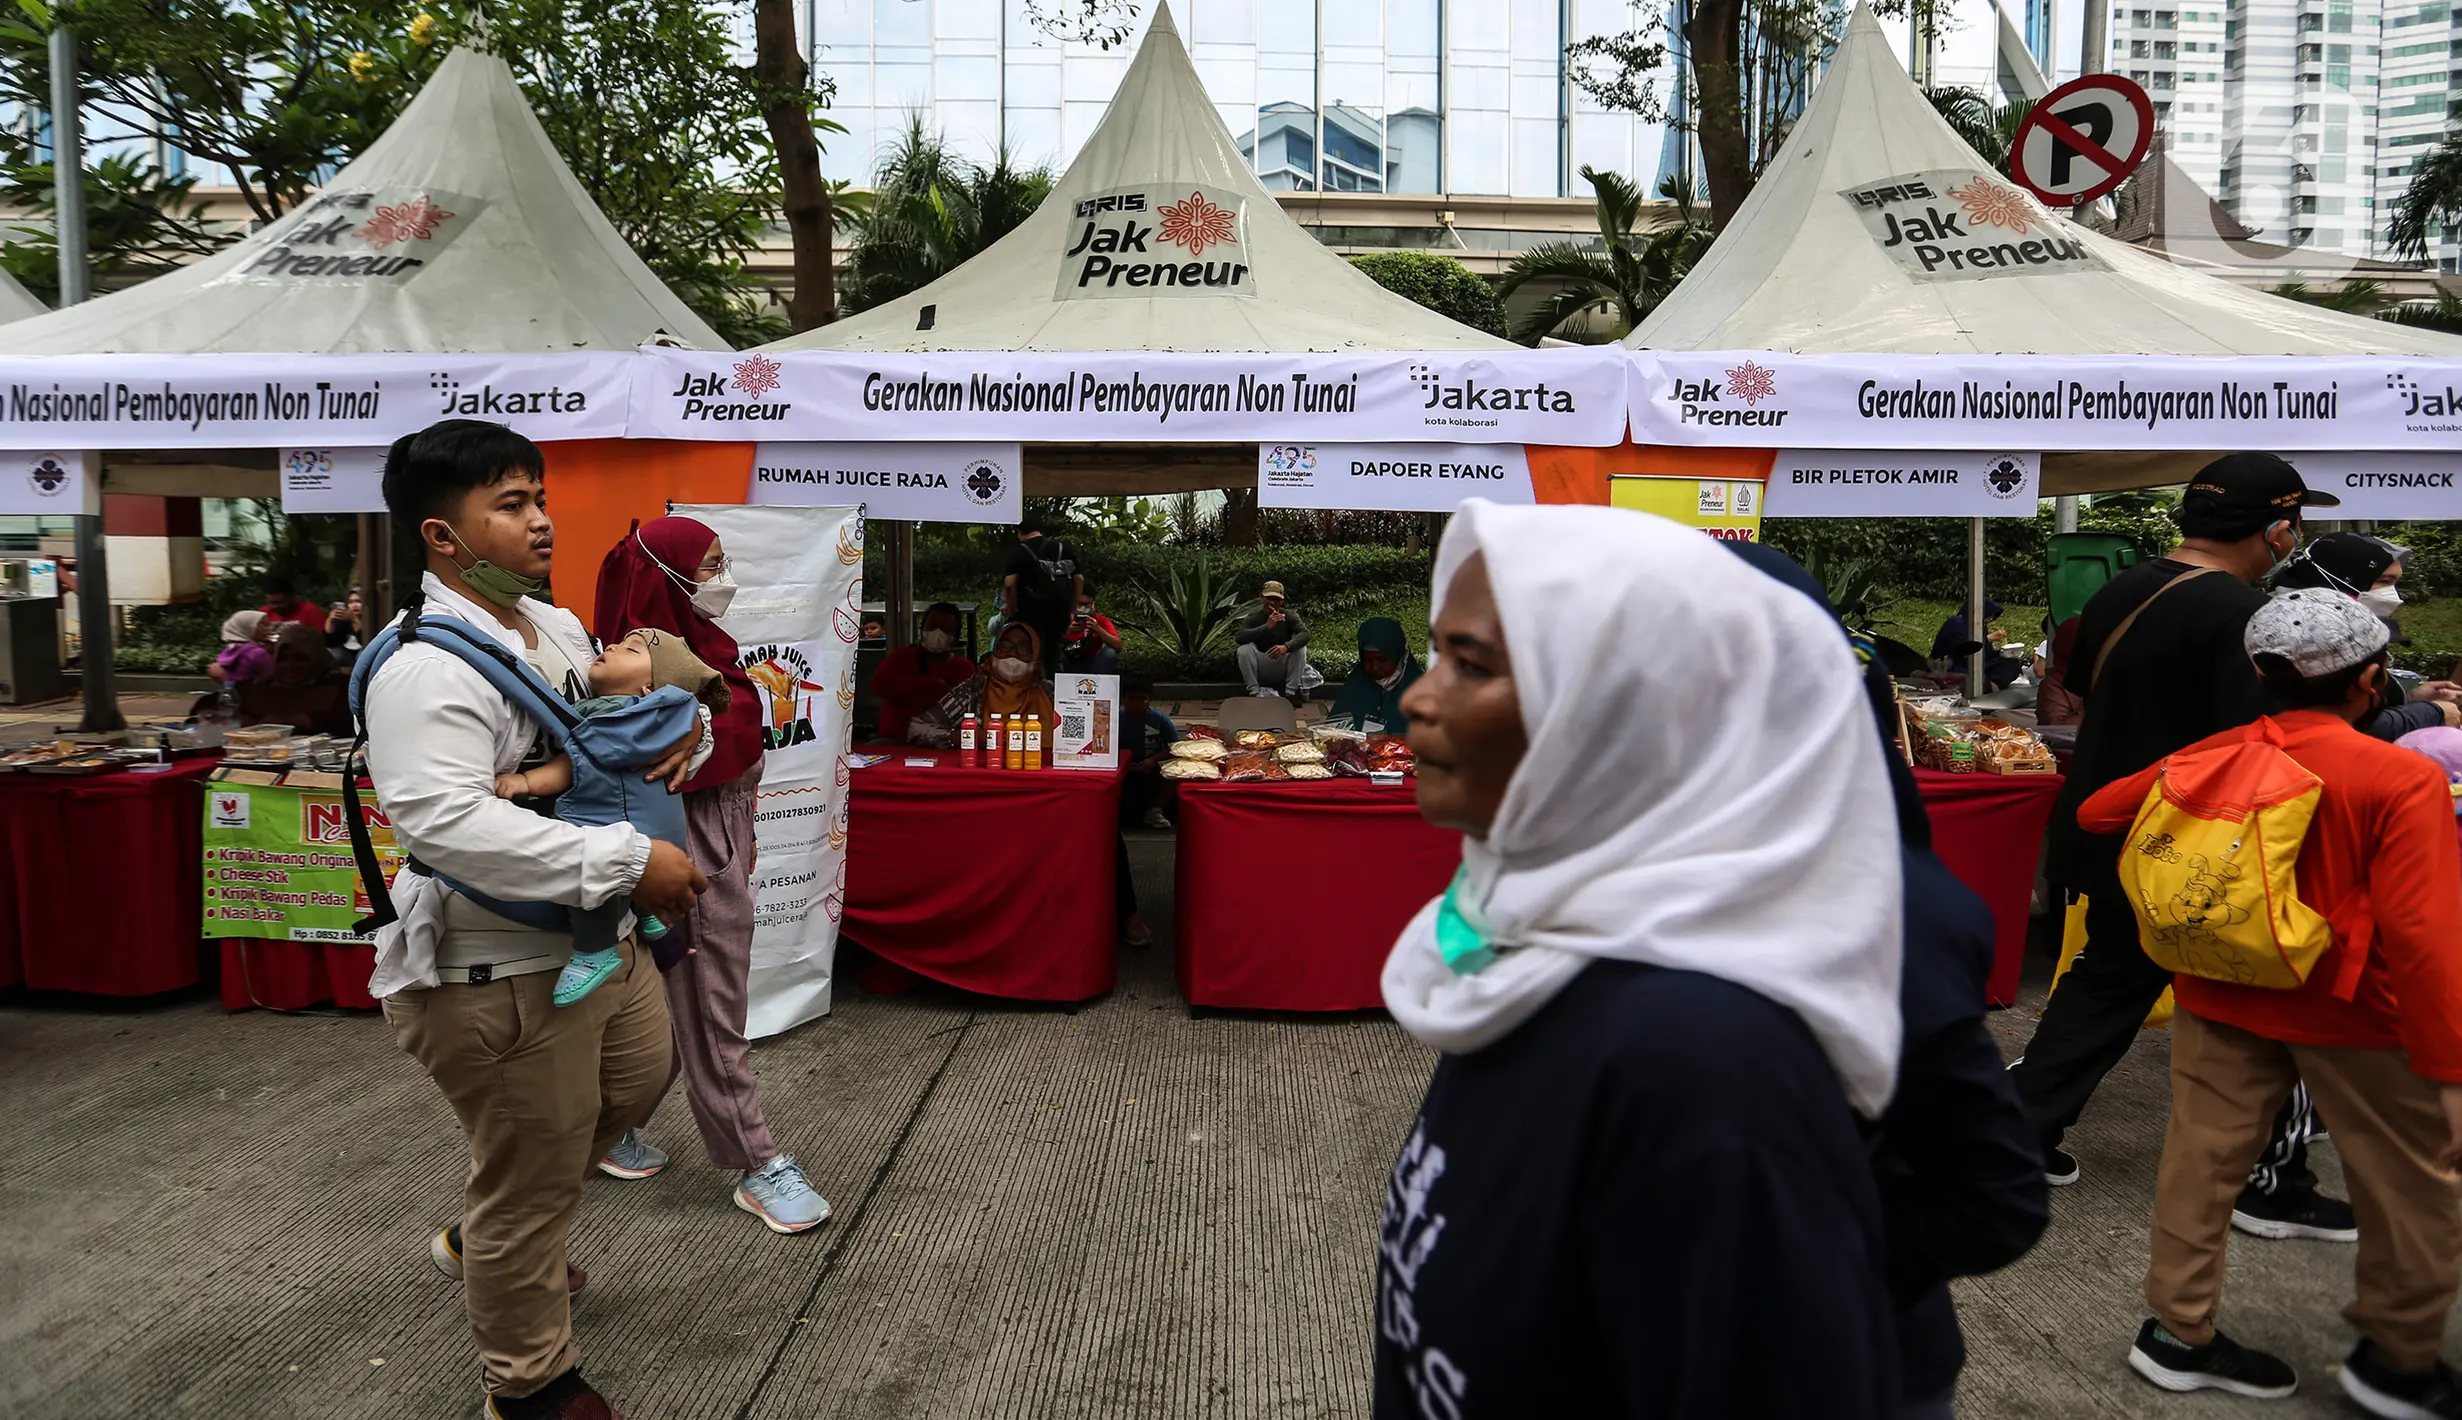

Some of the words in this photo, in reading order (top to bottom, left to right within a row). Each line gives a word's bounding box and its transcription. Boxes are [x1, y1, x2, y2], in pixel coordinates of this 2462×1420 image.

[1884, 207, 1967, 247] Jak
[1067, 220, 1152, 257] Jak
[246, 247, 423, 276] Preneur
[1913, 238, 2088, 271] Preneur
[1078, 255, 1249, 288] Preneur
[673, 372, 728, 397] Jak
[1668, 379, 1722, 402] Jak
[10, 384, 109, 422] Nasional
[116, 382, 258, 432] Pembayaran
[264, 383, 309, 421] Non
[316, 381, 380, 420] Tunai
[864, 372, 963, 412] Gerakan
[969, 372, 1074, 413] Nasional
[1079, 372, 1230, 424] Pembayaran
[1236, 374, 1284, 413] Non
[1291, 373, 1358, 413] Tunai
[1858, 380, 1956, 419] Gerakan
[1961, 380, 2063, 420] Nasional
[2068, 381, 2214, 431] Pembayaran
[2221, 382, 2267, 420] Non
[2273, 381, 2338, 420] Tunai
[682, 400, 791, 421] Preneur
[1681, 404, 1789, 427] Preneur
[1424, 418, 1447, 426] kota
[1449, 418, 1498, 428] kolaborasi
[2406, 424, 2429, 432] kota
[758, 467, 829, 485] RUMAH
[836, 470, 891, 487] JUICE
[897, 472, 948, 489] RAJA
[1350, 461, 1432, 478] DAPOER
[1438, 463, 1504, 480] EYANG
[1792, 470, 1824, 484] BIR
[1829, 470, 1903, 485] PLETOK
[1907, 470, 1959, 485] AMIR
[2345, 472, 2453, 488] CITYSNACK
[1700, 490, 1711, 498] Jak
[1701, 499, 1724, 507] Preneur
[782, 646, 812, 680] JUICE
[762, 718, 816, 750] AJA
[219, 849, 255, 864] Kripik
[258, 851, 305, 868] Bawang
[220, 868, 263, 882] Cheese
[265, 870, 289, 884] Stik
[770, 870, 817, 888] PESANAN
[220, 887, 257, 902] Kripik
[260, 890, 306, 907] Bawang
[310, 892, 347, 906] Pedas
[220, 907, 249, 920] Nasi
[252, 909, 285, 922] Bakar
[316, 931, 339, 940] 0852
